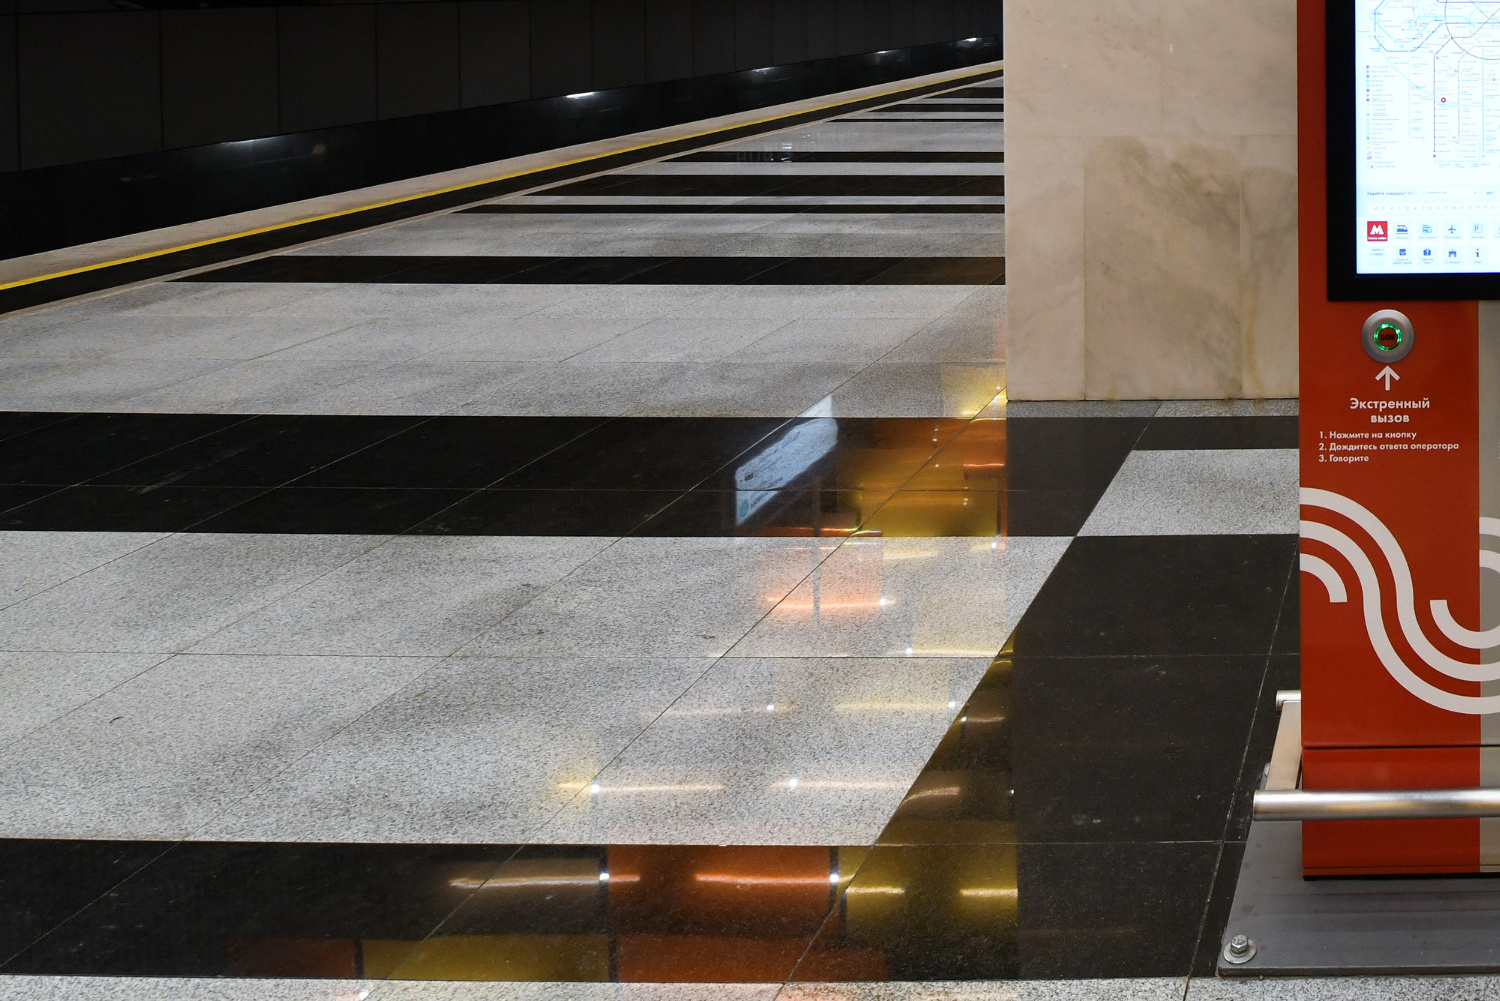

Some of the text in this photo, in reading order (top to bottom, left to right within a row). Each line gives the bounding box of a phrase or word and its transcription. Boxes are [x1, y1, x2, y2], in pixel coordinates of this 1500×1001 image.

[1349, 397, 1431, 411] Экстренный
[1370, 413, 1410, 424] вызов
[1319, 431, 1417, 441] 1. Нажмите на кнопку
[1318, 442, 1459, 452] 2. Дождитесь ответа оператора
[1318, 454, 1370, 464] 3. Говорите
